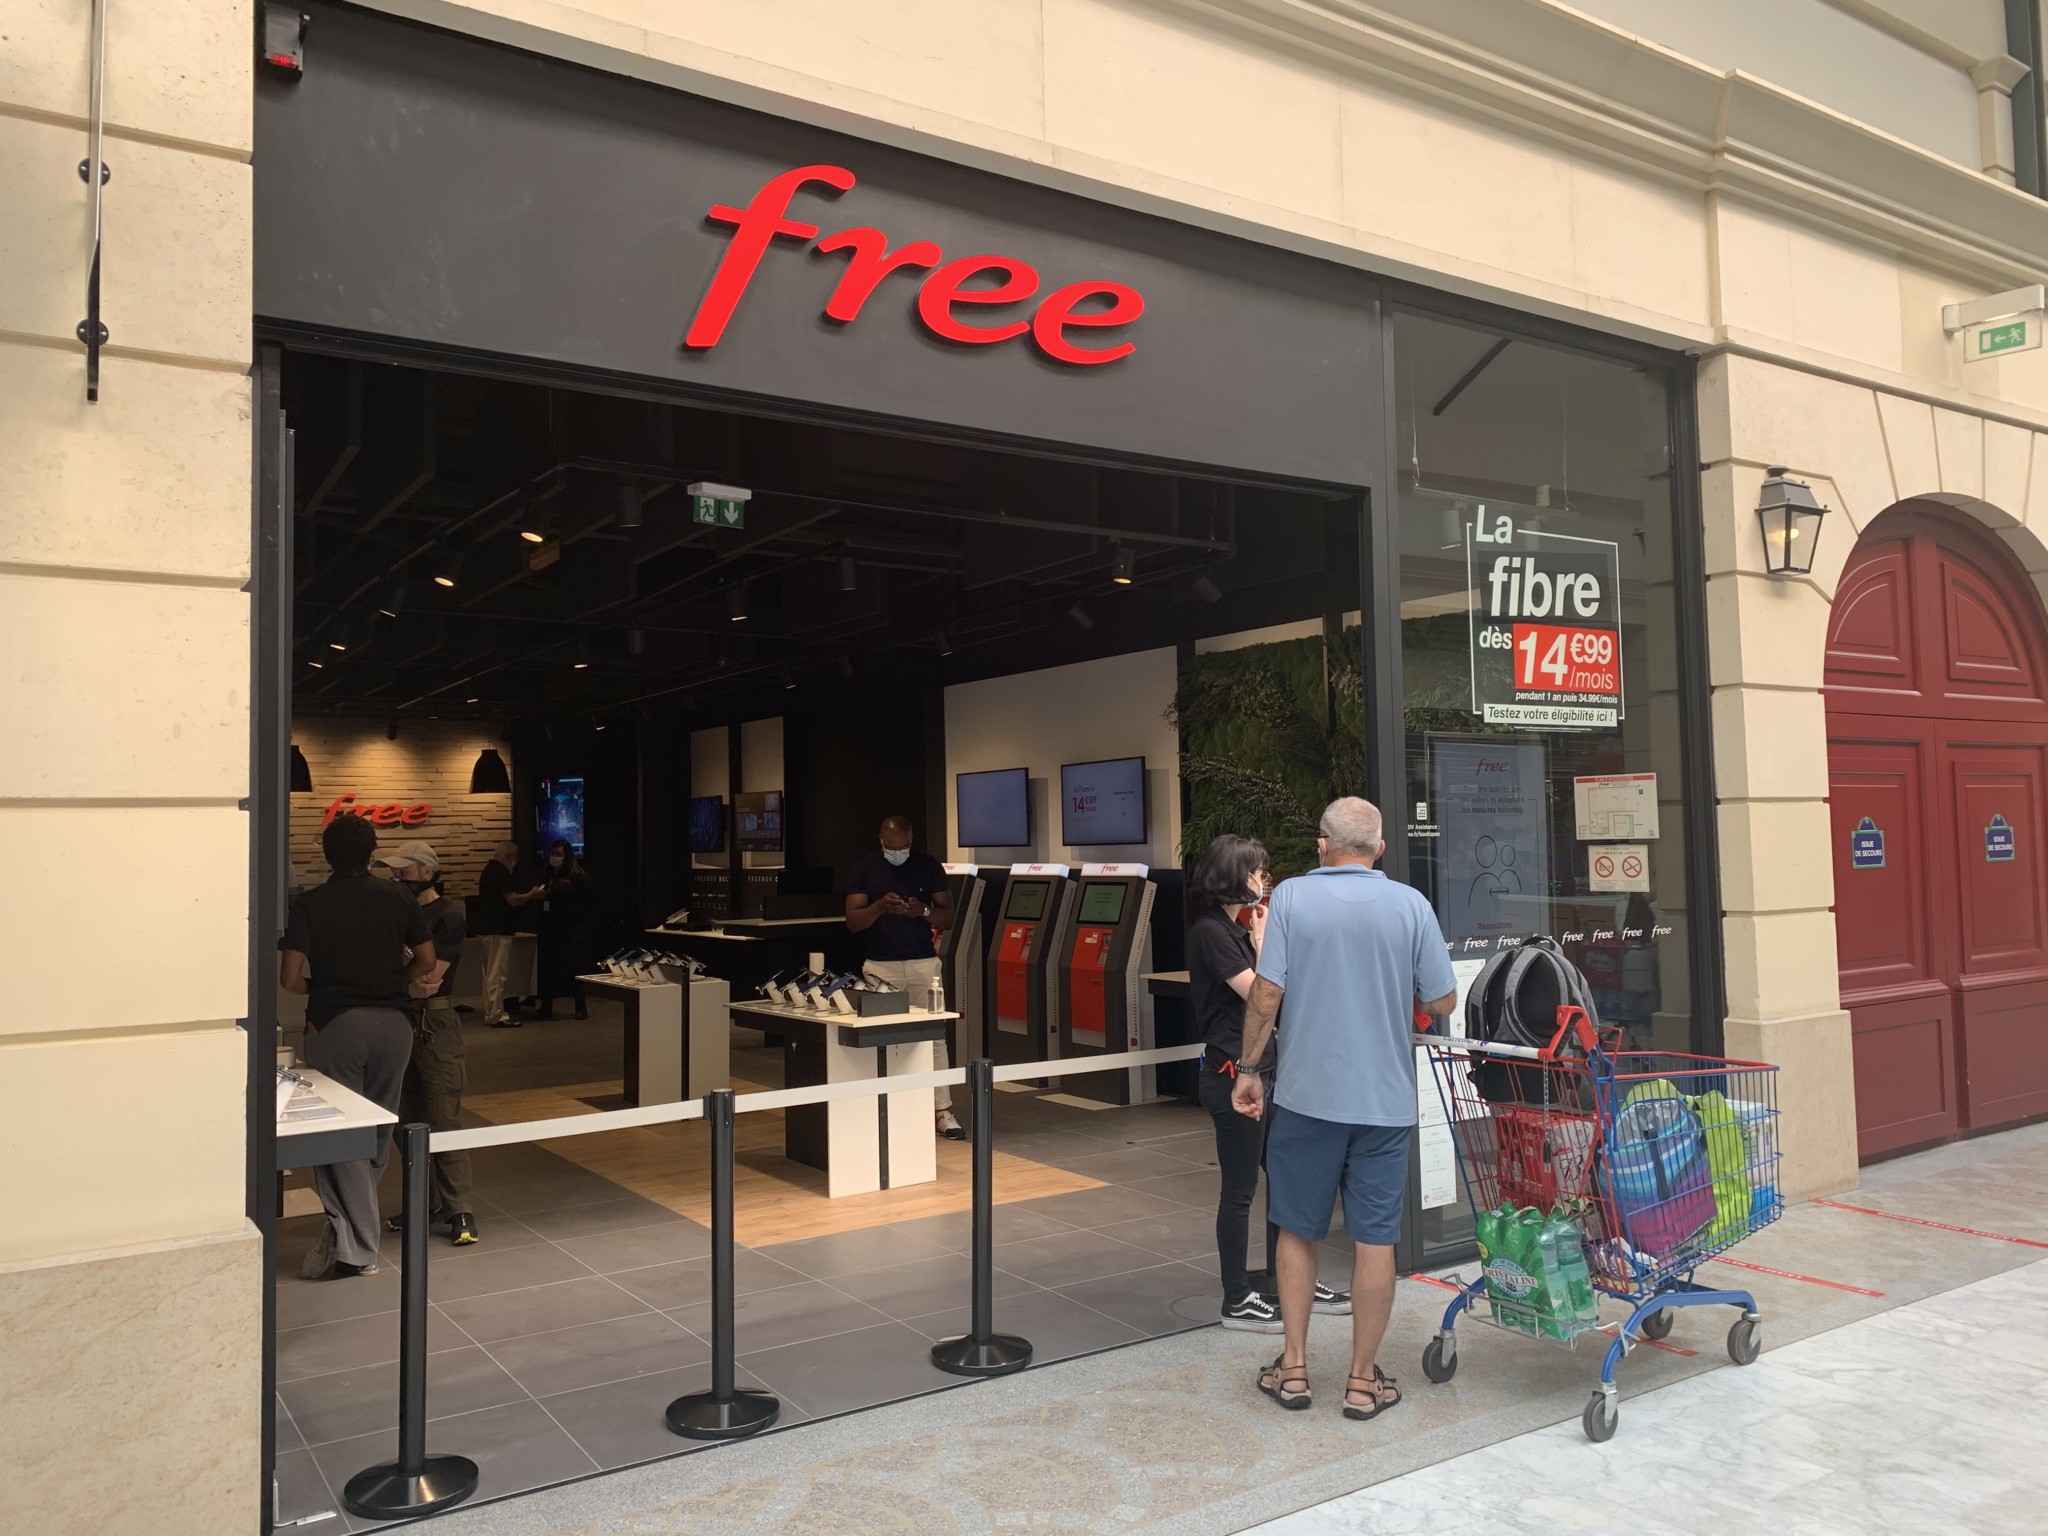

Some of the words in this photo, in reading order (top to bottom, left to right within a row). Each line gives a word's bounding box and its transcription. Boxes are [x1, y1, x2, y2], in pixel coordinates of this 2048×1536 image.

[686, 164, 1145, 364] free
[1475, 504, 1513, 544] La
[1488, 556, 1601, 617] fibre
[1478, 625, 1513, 650] dès
[1569, 665, 1614, 690] /mois
[1515, 691, 1545, 701] pendant
[1547, 692, 1551, 701] 1
[1562, 693, 1578, 703] puis
[1488, 706, 1521, 719] Testez
[1523, 709, 1549, 720] votre
[1551, 708, 1594, 723] éligibilité
[1596, 710, 1608, 722] ici
[1476, 757, 1508, 776] free
[314, 793, 433, 840] free
[1861, 840, 1874, 848] ISSUE
[1993, 835, 2005, 843] ISSUE
[1994, 843, 2013, 851] SECOURS
[1862, 849, 1883, 857] SECOURS
[1027, 863, 1043, 873] free
[1100, 863, 1119, 873] free
[1464, 937, 1488, 952] free
[1497, 935, 1521, 949] free
[1561, 931, 1584, 945] free
[1592, 929, 1614, 943] free
[1622, 927, 1643, 940] free
[1651, 925, 1672, 938] free
